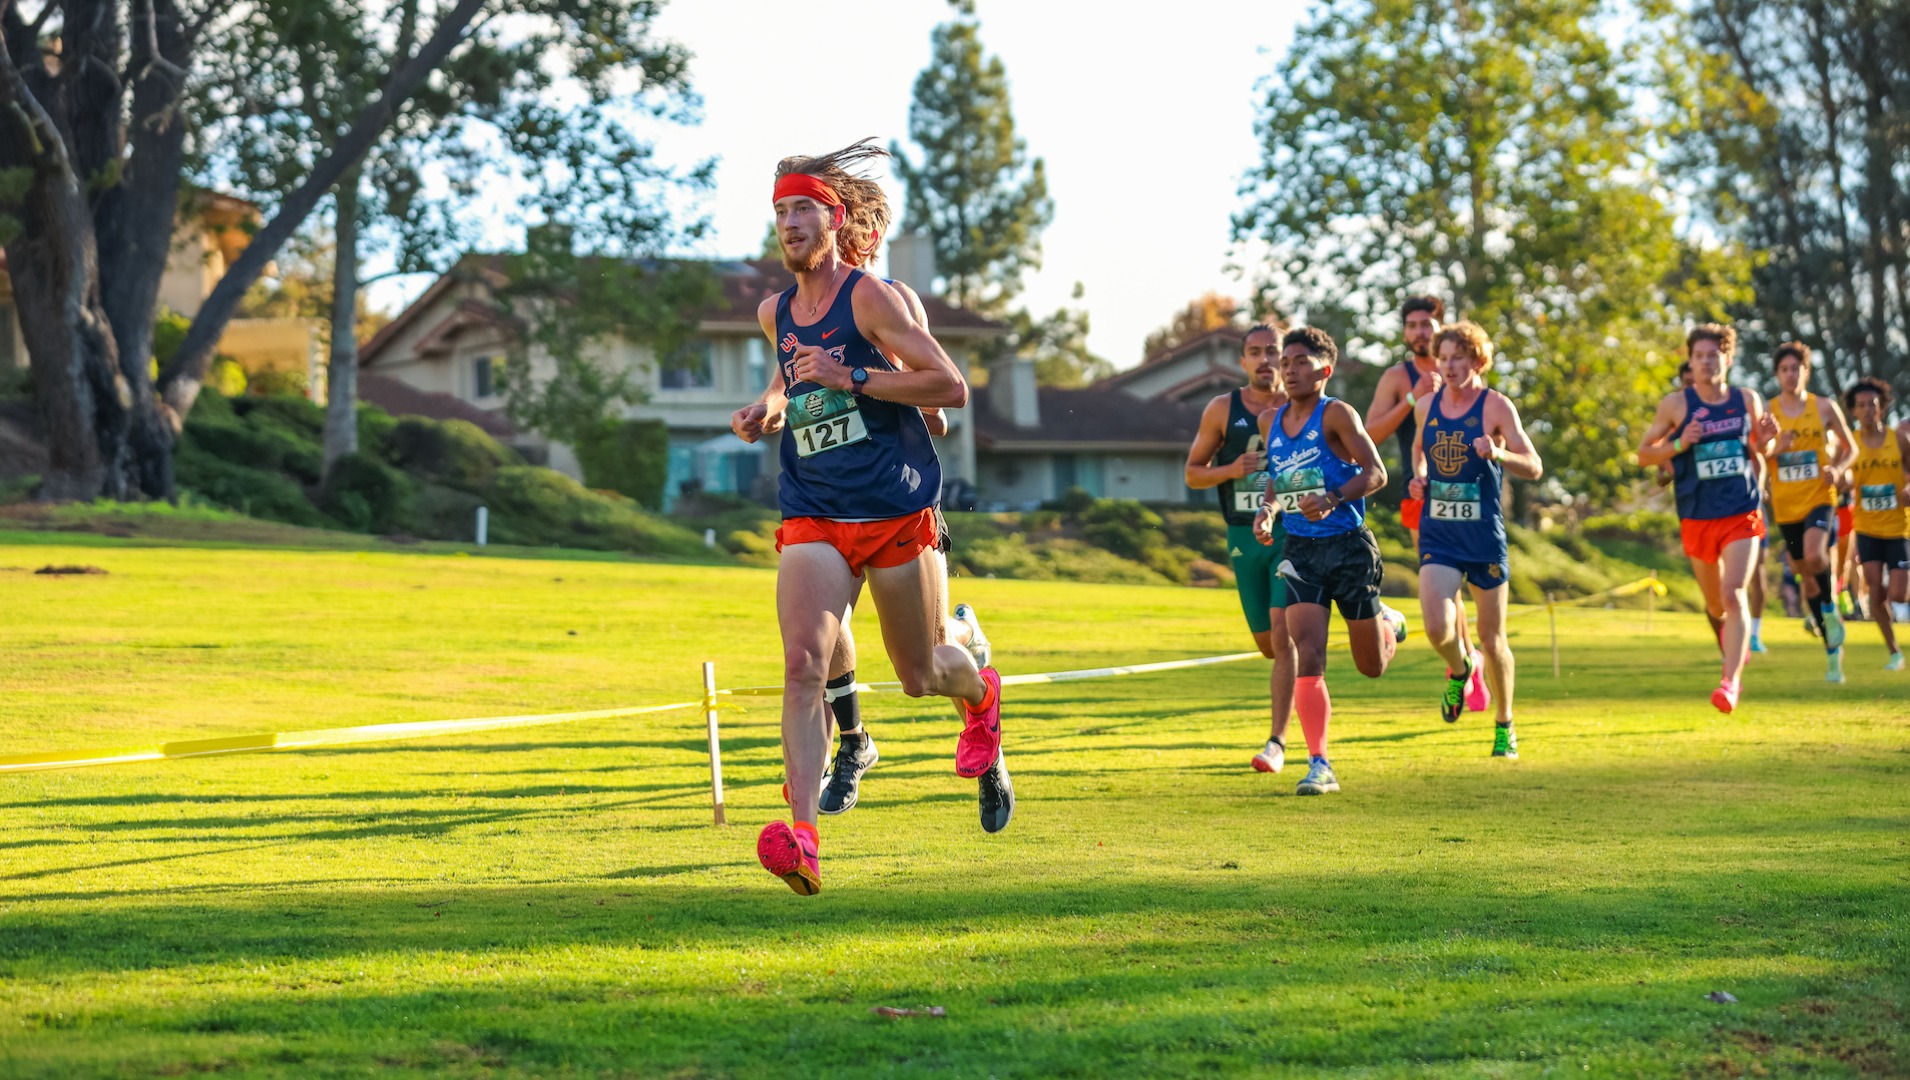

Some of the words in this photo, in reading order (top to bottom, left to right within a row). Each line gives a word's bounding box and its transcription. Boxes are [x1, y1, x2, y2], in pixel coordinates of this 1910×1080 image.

[802, 416, 850, 452] 127
[1705, 457, 1740, 475] 124
[1784, 465, 1813, 479] 178
[1243, 492, 1266, 509] 10
[1436, 502, 1473, 518] 218
